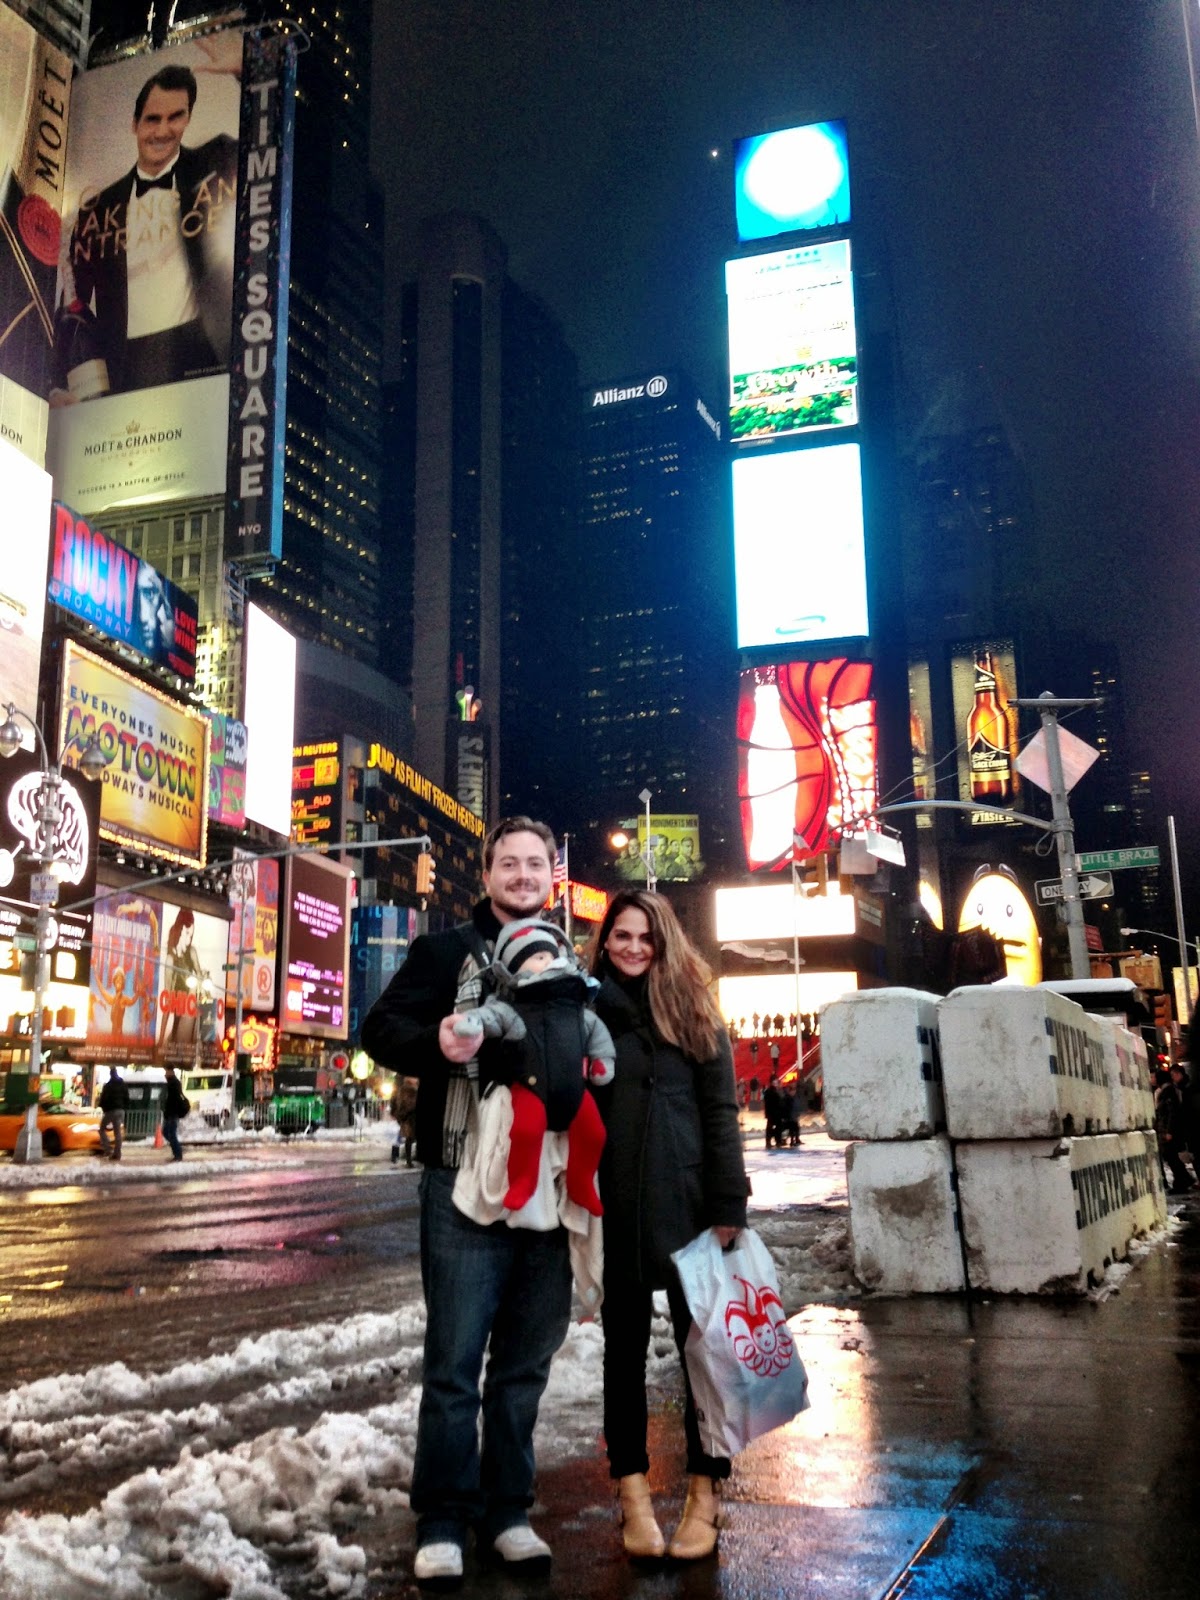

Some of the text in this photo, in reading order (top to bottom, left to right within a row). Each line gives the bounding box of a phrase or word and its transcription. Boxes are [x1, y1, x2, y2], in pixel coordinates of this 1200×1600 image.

[240, 79, 278, 499] TIMES SQUARE
[592, 385, 645, 407] Allianz
[125, 428, 183, 448] CHANDON
[238, 524, 261, 537] NYC
[53, 504, 138, 625] ROCKY
[51, 581, 130, 637] BROADWAY
[70, 685, 153, 738] EVERYONE'S
[160, 731, 196, 760] MUSIC
[65, 705, 196, 802] MOTOWN
[368, 743, 396, 774] JUMP
[395, 758, 406, 784] AS
[405, 765, 421, 796] FILM
[421, 775, 432, 803] HIT
[458, 736, 483, 818] SHEY'S
[149, 790, 193, 818] MUSICAL
[1081, 848, 1158, 865] LITTLE BRAZIL
[1044, 886, 1063, 897] ONE
[159, 989, 225, 1020] CHICO
